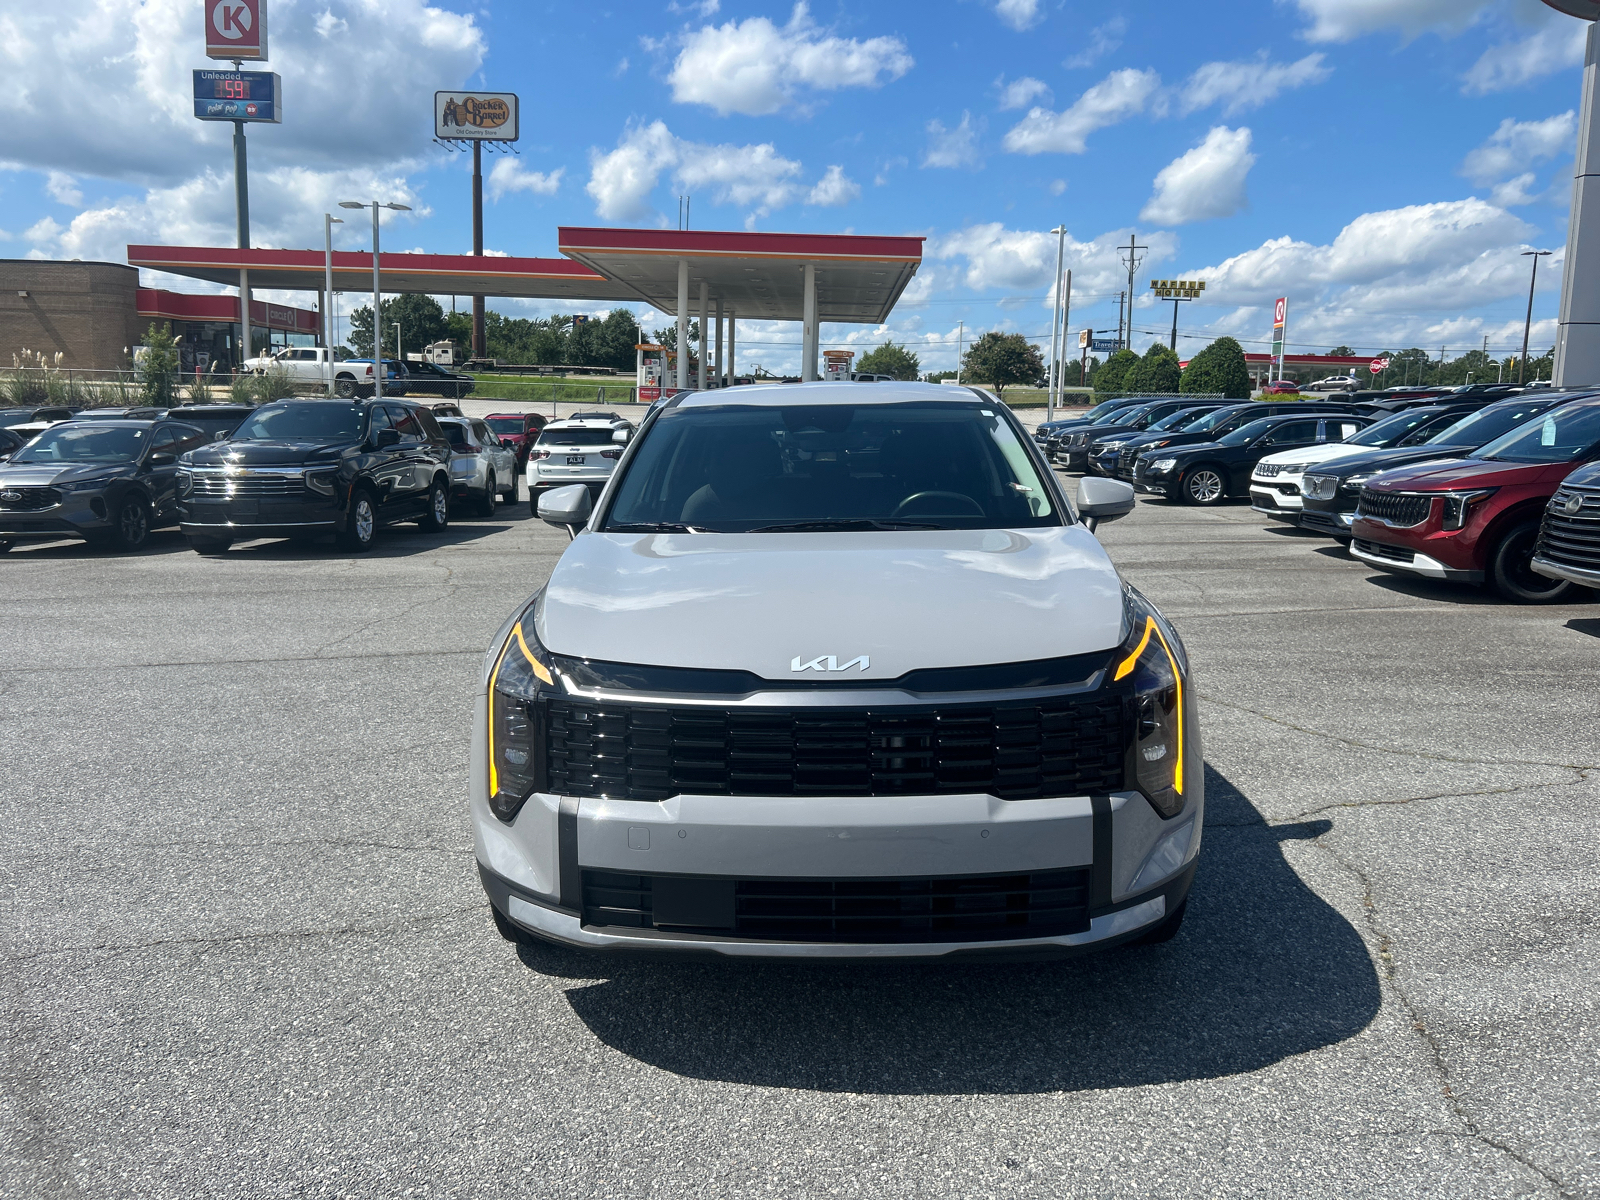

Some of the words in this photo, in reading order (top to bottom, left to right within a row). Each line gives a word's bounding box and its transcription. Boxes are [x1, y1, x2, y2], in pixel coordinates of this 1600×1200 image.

[222, 5, 248, 37] K
[201, 71, 241, 81] Unleaded
[464, 98, 504, 115] Cracker
[472, 110, 506, 127] Barrel
[1151, 280, 1205, 289] WAFFLE
[1155, 289, 1200, 298] HOUSE
[270, 310, 287, 321] CIRCLE
[791, 655, 870, 672] KIA
